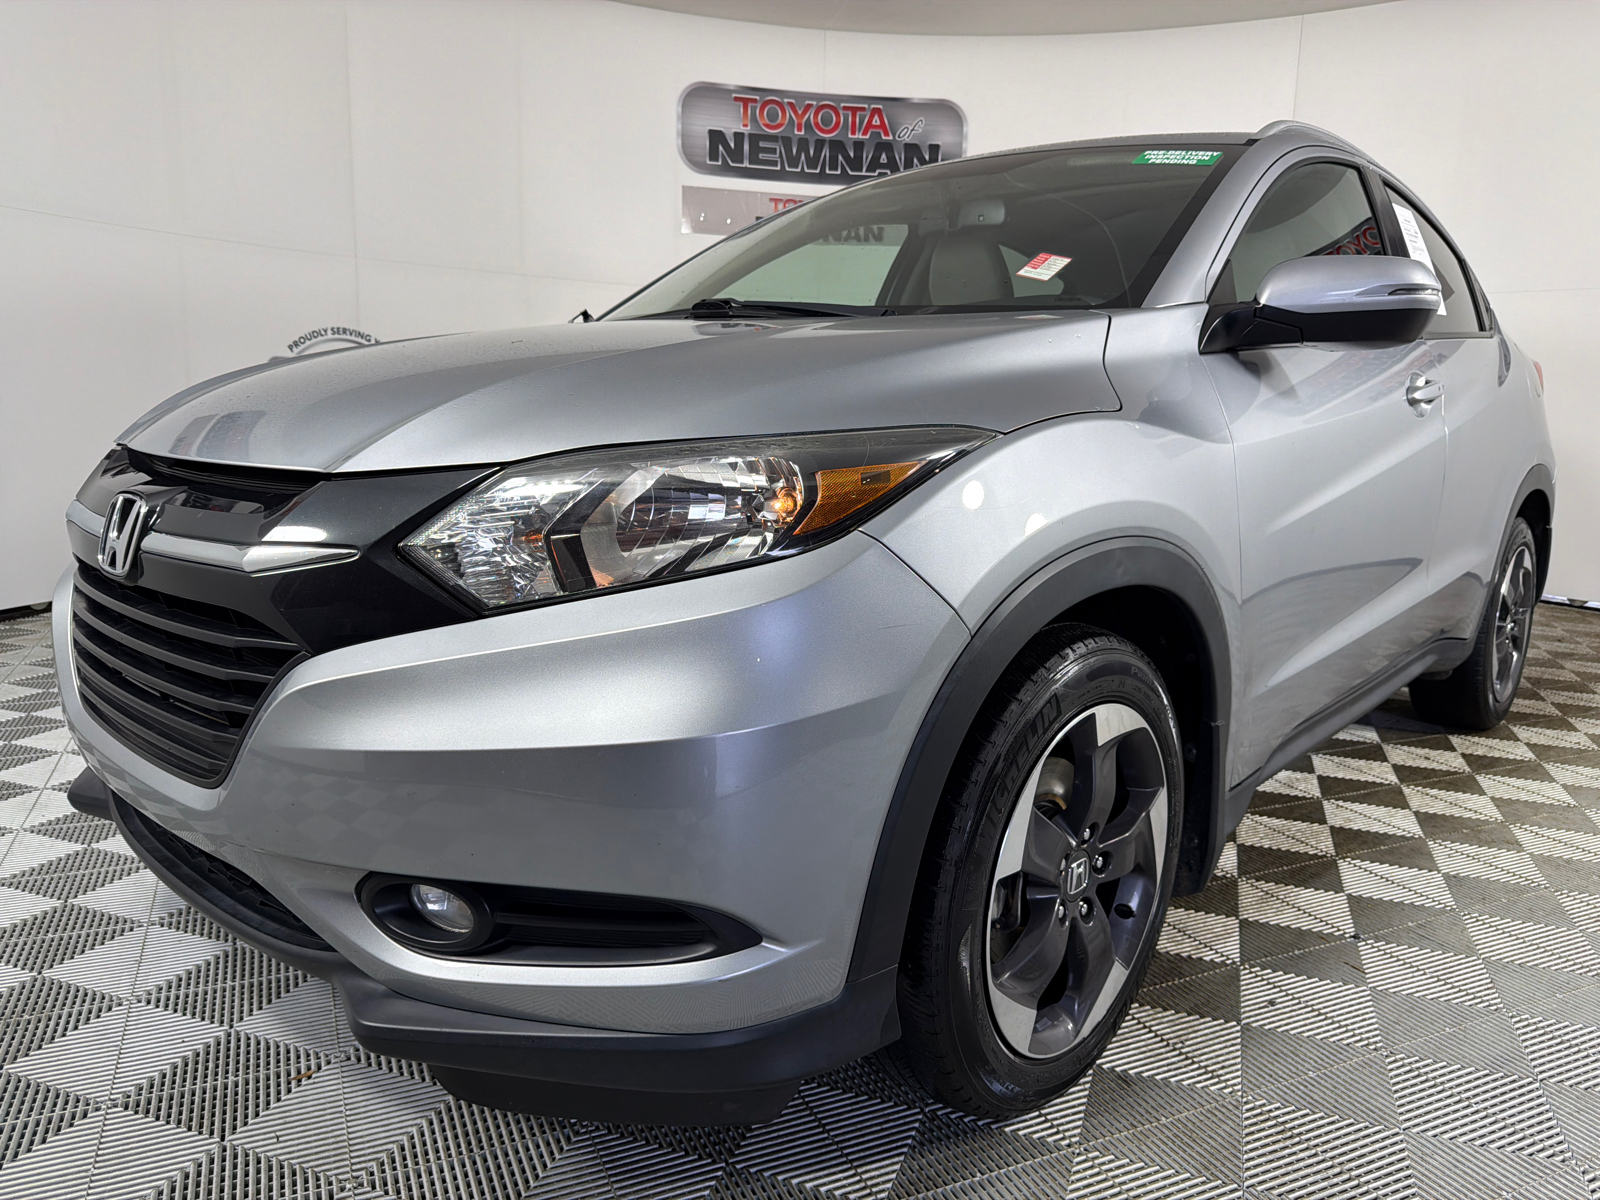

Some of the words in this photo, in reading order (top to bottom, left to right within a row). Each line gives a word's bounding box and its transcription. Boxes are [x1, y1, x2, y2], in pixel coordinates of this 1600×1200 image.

[732, 94, 893, 140] TOYOTA
[895, 117, 925, 141] of
[707, 129, 941, 176] NEWNAN
[822, 226, 885, 243] NAN
[287, 327, 328, 353] PROUDLY
[330, 326, 372, 343] SERVING
